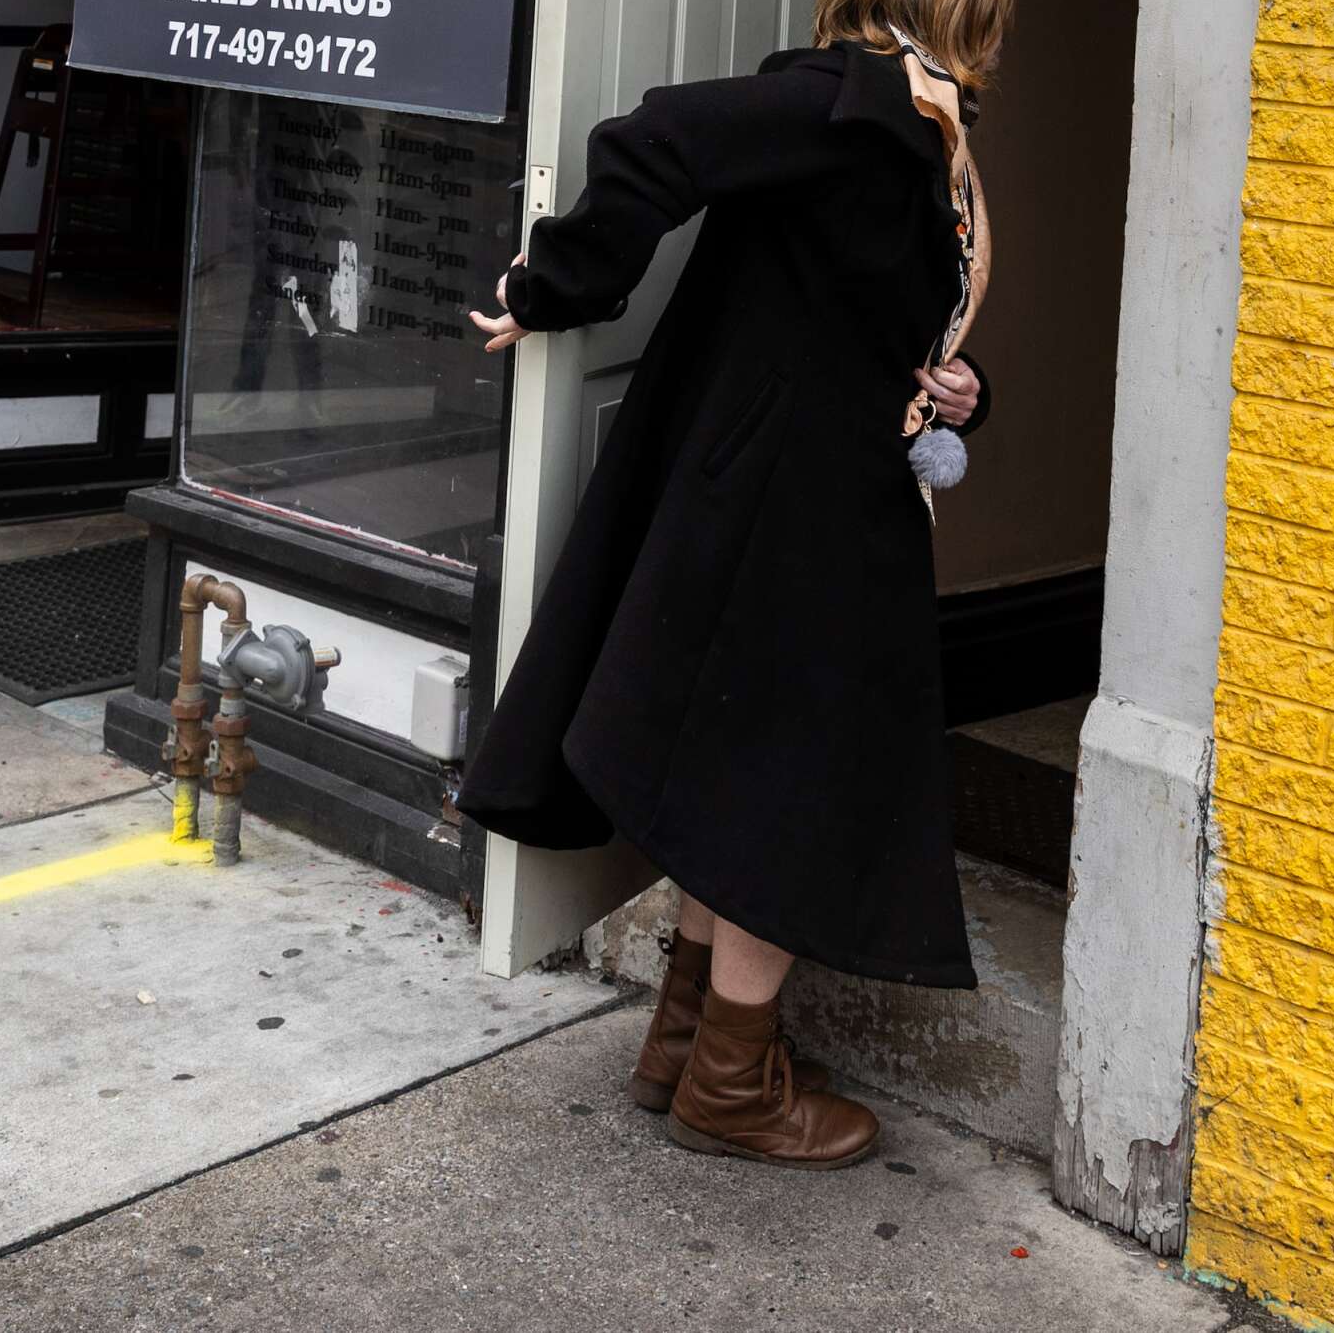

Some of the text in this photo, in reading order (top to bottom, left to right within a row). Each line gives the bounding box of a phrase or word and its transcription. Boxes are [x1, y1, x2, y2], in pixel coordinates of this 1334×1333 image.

[167, 20, 377, 79] 717-497-9172
[276, 112, 341, 147] Tuesday
[272, 177, 348, 215] Thursday
[273, 144, 473, 201] Wednesday 11am-8pm
[267, 209, 468, 271] Friday 11am-9pm
[266, 243, 465, 305] Saturday 11am-9pm
[368, 305, 464, 340] 11pm-5pm
